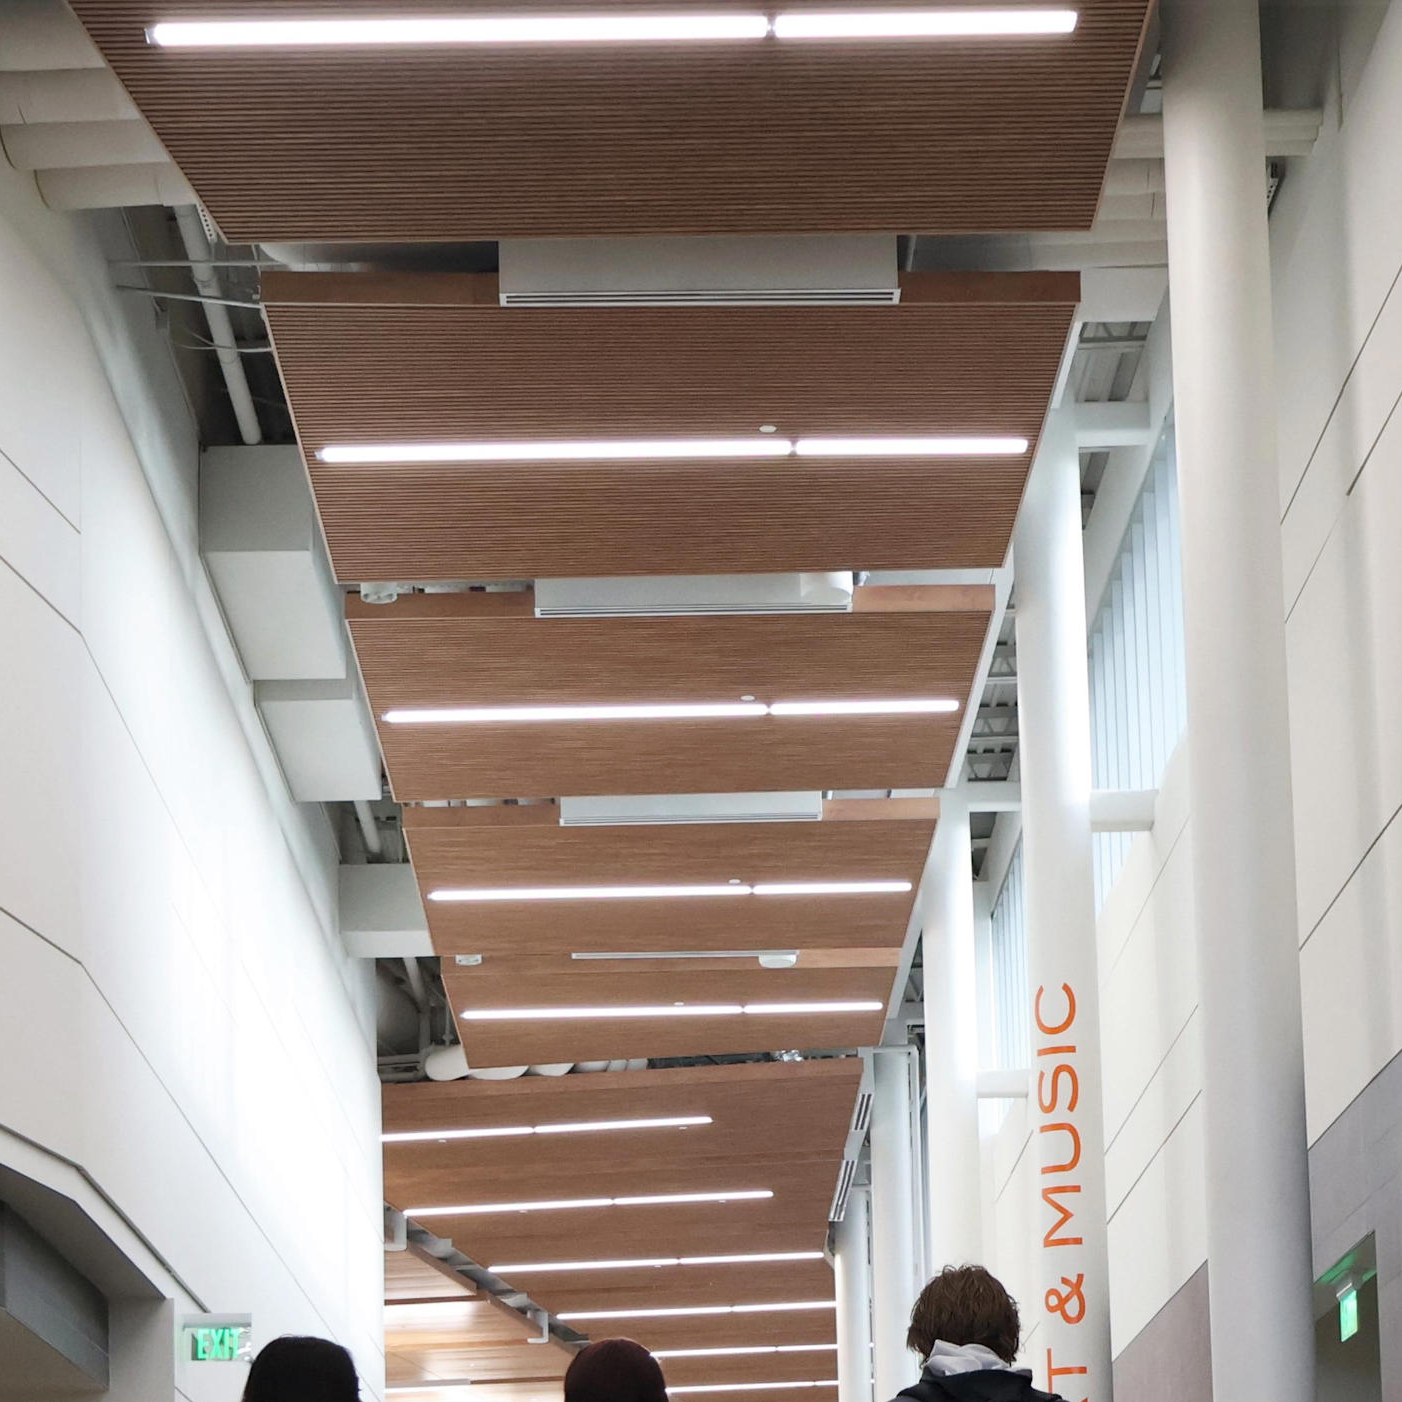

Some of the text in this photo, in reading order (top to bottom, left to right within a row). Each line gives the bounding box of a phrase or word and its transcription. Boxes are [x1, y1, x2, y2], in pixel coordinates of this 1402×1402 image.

[1034, 981, 1084, 1248] MUSIC
[1044, 1272, 1087, 1325] &
[197, 1327, 240, 1360] EXIT
